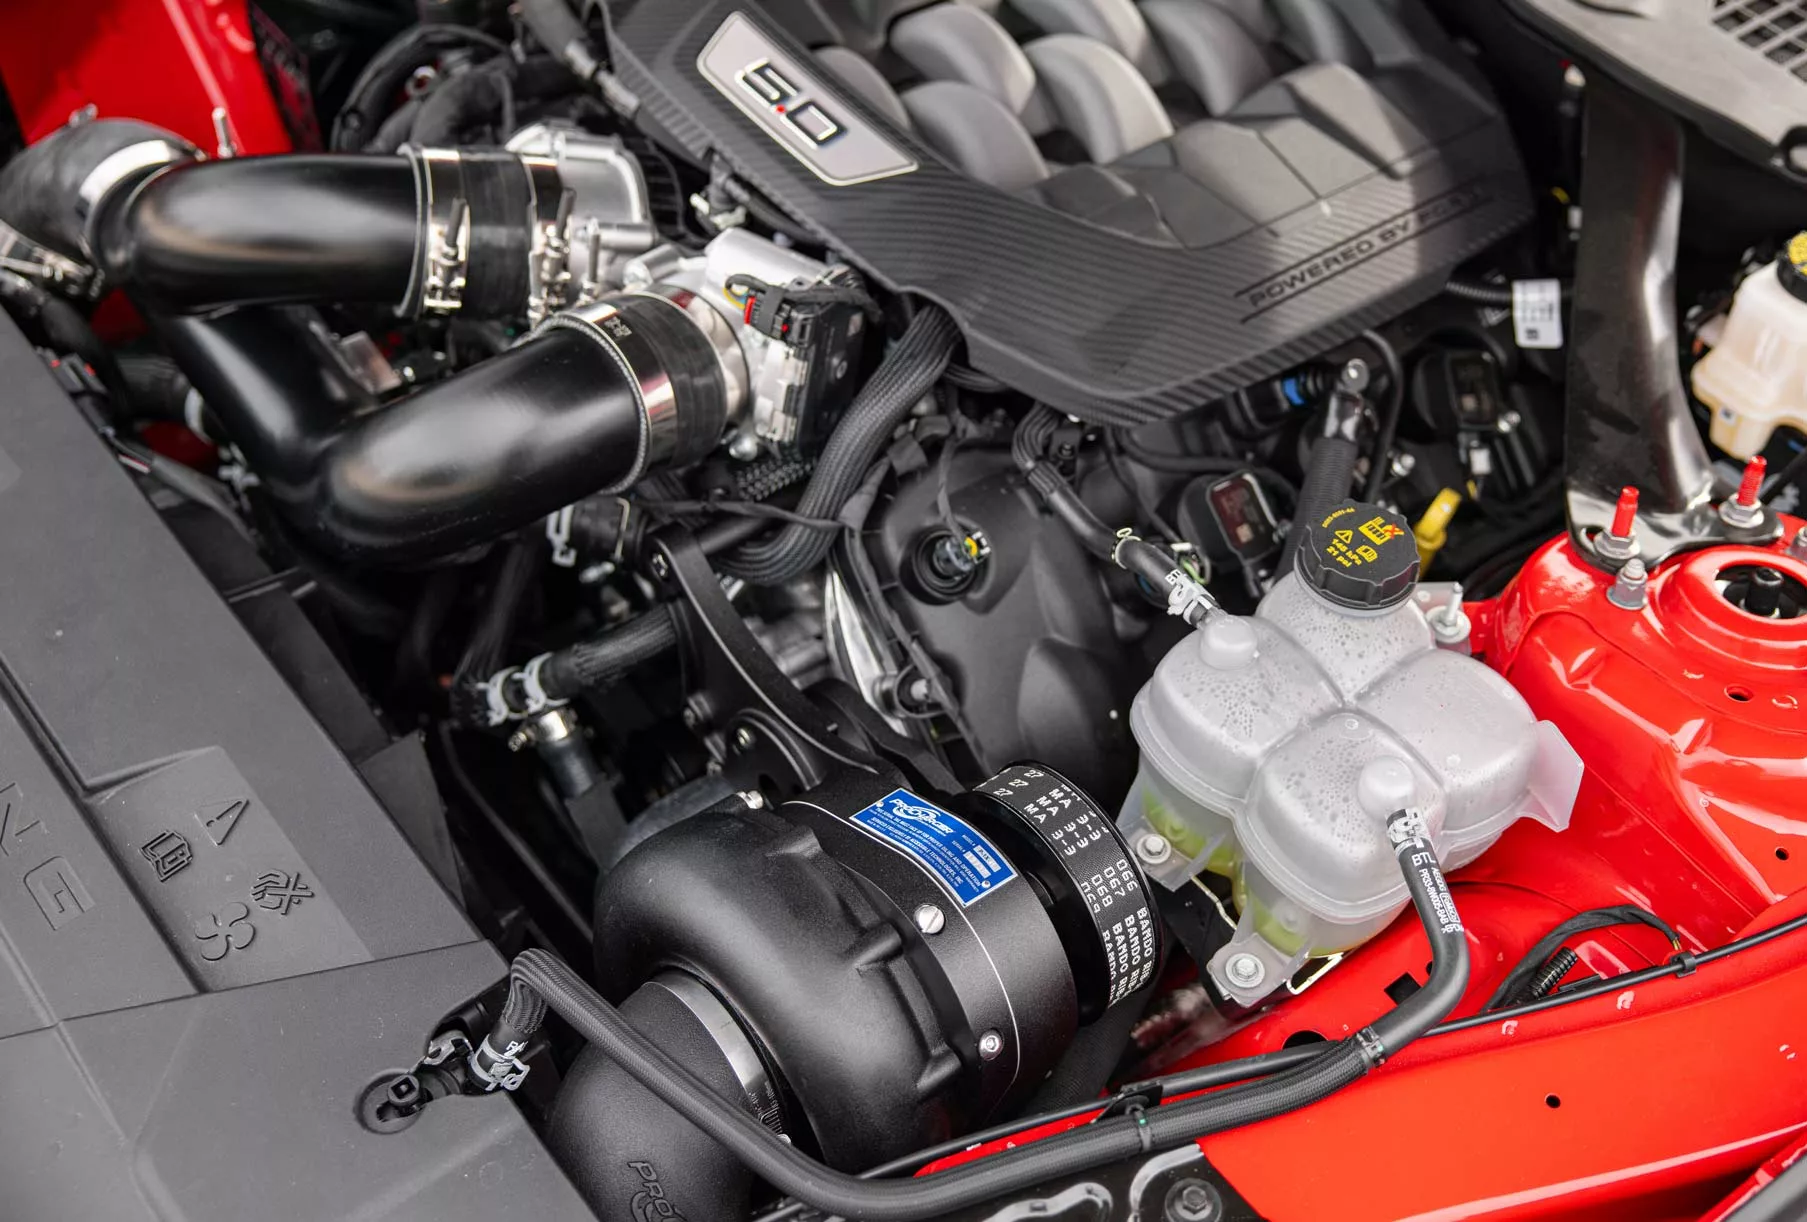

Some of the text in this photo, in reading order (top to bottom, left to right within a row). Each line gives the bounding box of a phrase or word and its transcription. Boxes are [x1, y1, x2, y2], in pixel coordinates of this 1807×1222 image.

[734, 57, 848, 150] 5.0
[1250, 240, 1375, 306] POWERED
[1378, 219, 1411, 243] BY
[993, 787, 1013, 797] 27
[1023, 803, 1047, 824] MA
[1051, 829, 1077, 856] 3-3
[1091, 874, 1113, 908] 068
[1112, 922, 1129, 974] BANDO
[1008, 779, 1029, 788] 27
[1036, 796, 1059, 816] MA
[1064, 821, 1089, 849] 3-3
[1103, 866, 1126, 897] 067
[1124, 915, 1141, 965] BANDO
[1024, 769, 1044, 778] 27
[1049, 788, 1072, 808] MA
[1076, 814, 1101, 841] 3-3
[1117, 858, 1138, 892] 066
[1136, 907, 1153, 958] BANDO
